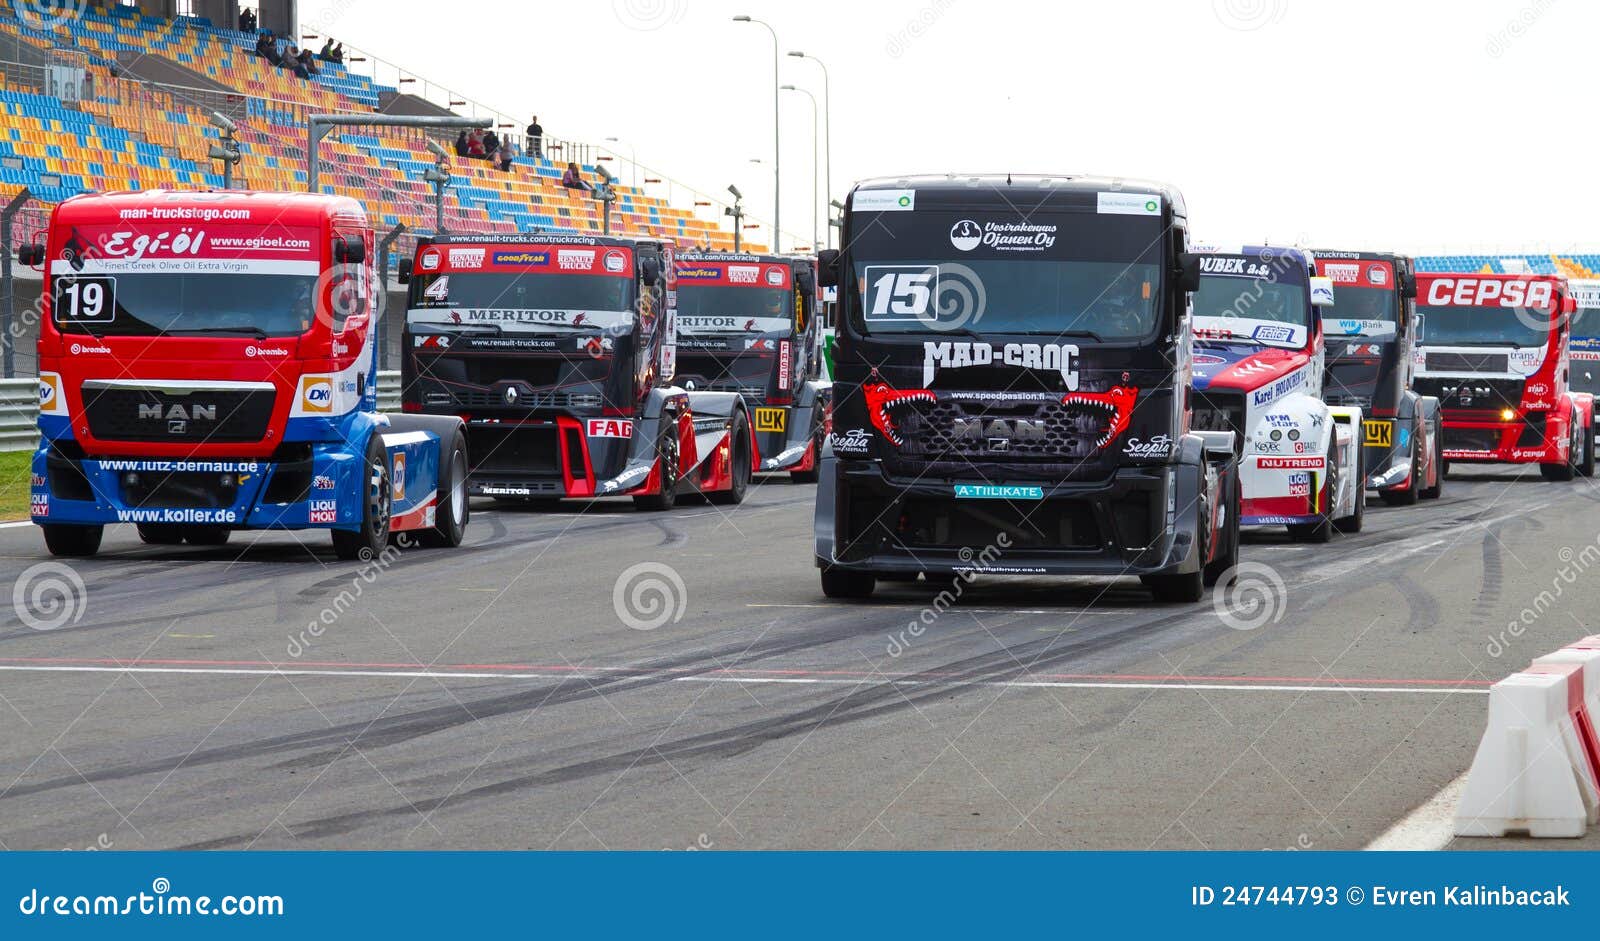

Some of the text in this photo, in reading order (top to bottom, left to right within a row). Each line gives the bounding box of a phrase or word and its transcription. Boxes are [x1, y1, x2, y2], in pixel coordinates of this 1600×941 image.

[119, 206, 250, 220] man-truckstogo.com
[985, 222, 1057, 232] Vesirakennus
[210, 236, 310, 250] www.egioel.com
[449, 235, 595, 245] www.renault-trucks.com/truckracing
[983, 232, 1056, 247] Ojanen Oy
[496, 253, 545, 263] GOODYEAR
[105, 261, 248, 272] Finest Greek Olive Oil Extra Virgin
[451, 261, 482, 269] TRUCKS
[560, 262, 592, 270] TRUCKS
[424, 275, 449, 300] 4
[1428, 278, 1552, 308] CEPSA
[65, 282, 103, 316] 19
[871, 273, 932, 315] 15
[468, 310, 567, 321] MERITOR
[1340, 320, 1383, 329] WIR Bank
[471, 339, 556, 348] www.renault-trucks.com
[82, 345, 111, 354] brembo
[257, 348, 288, 356] brembo
[1510, 352, 1535, 360] trans
[780, 340, 789, 389] FASSI
[923, 341, 1079, 392] MAD-CROC
[951, 392, 1045, 401] www.speedpassion.fi
[1254, 387, 1273, 406] Karel
[138, 404, 217, 420] MAN
[757, 410, 784, 429] LUK
[589, 420, 632, 437] FAG
[954, 418, 1046, 438] MAN
[1261, 459, 1322, 467] NUTREND
[958, 486, 1039, 497] A-TIILIKATE
[311, 501, 336, 511] LIQUI
[117, 508, 236, 523] www.koller.de
[311, 511, 336, 522] MOLY
